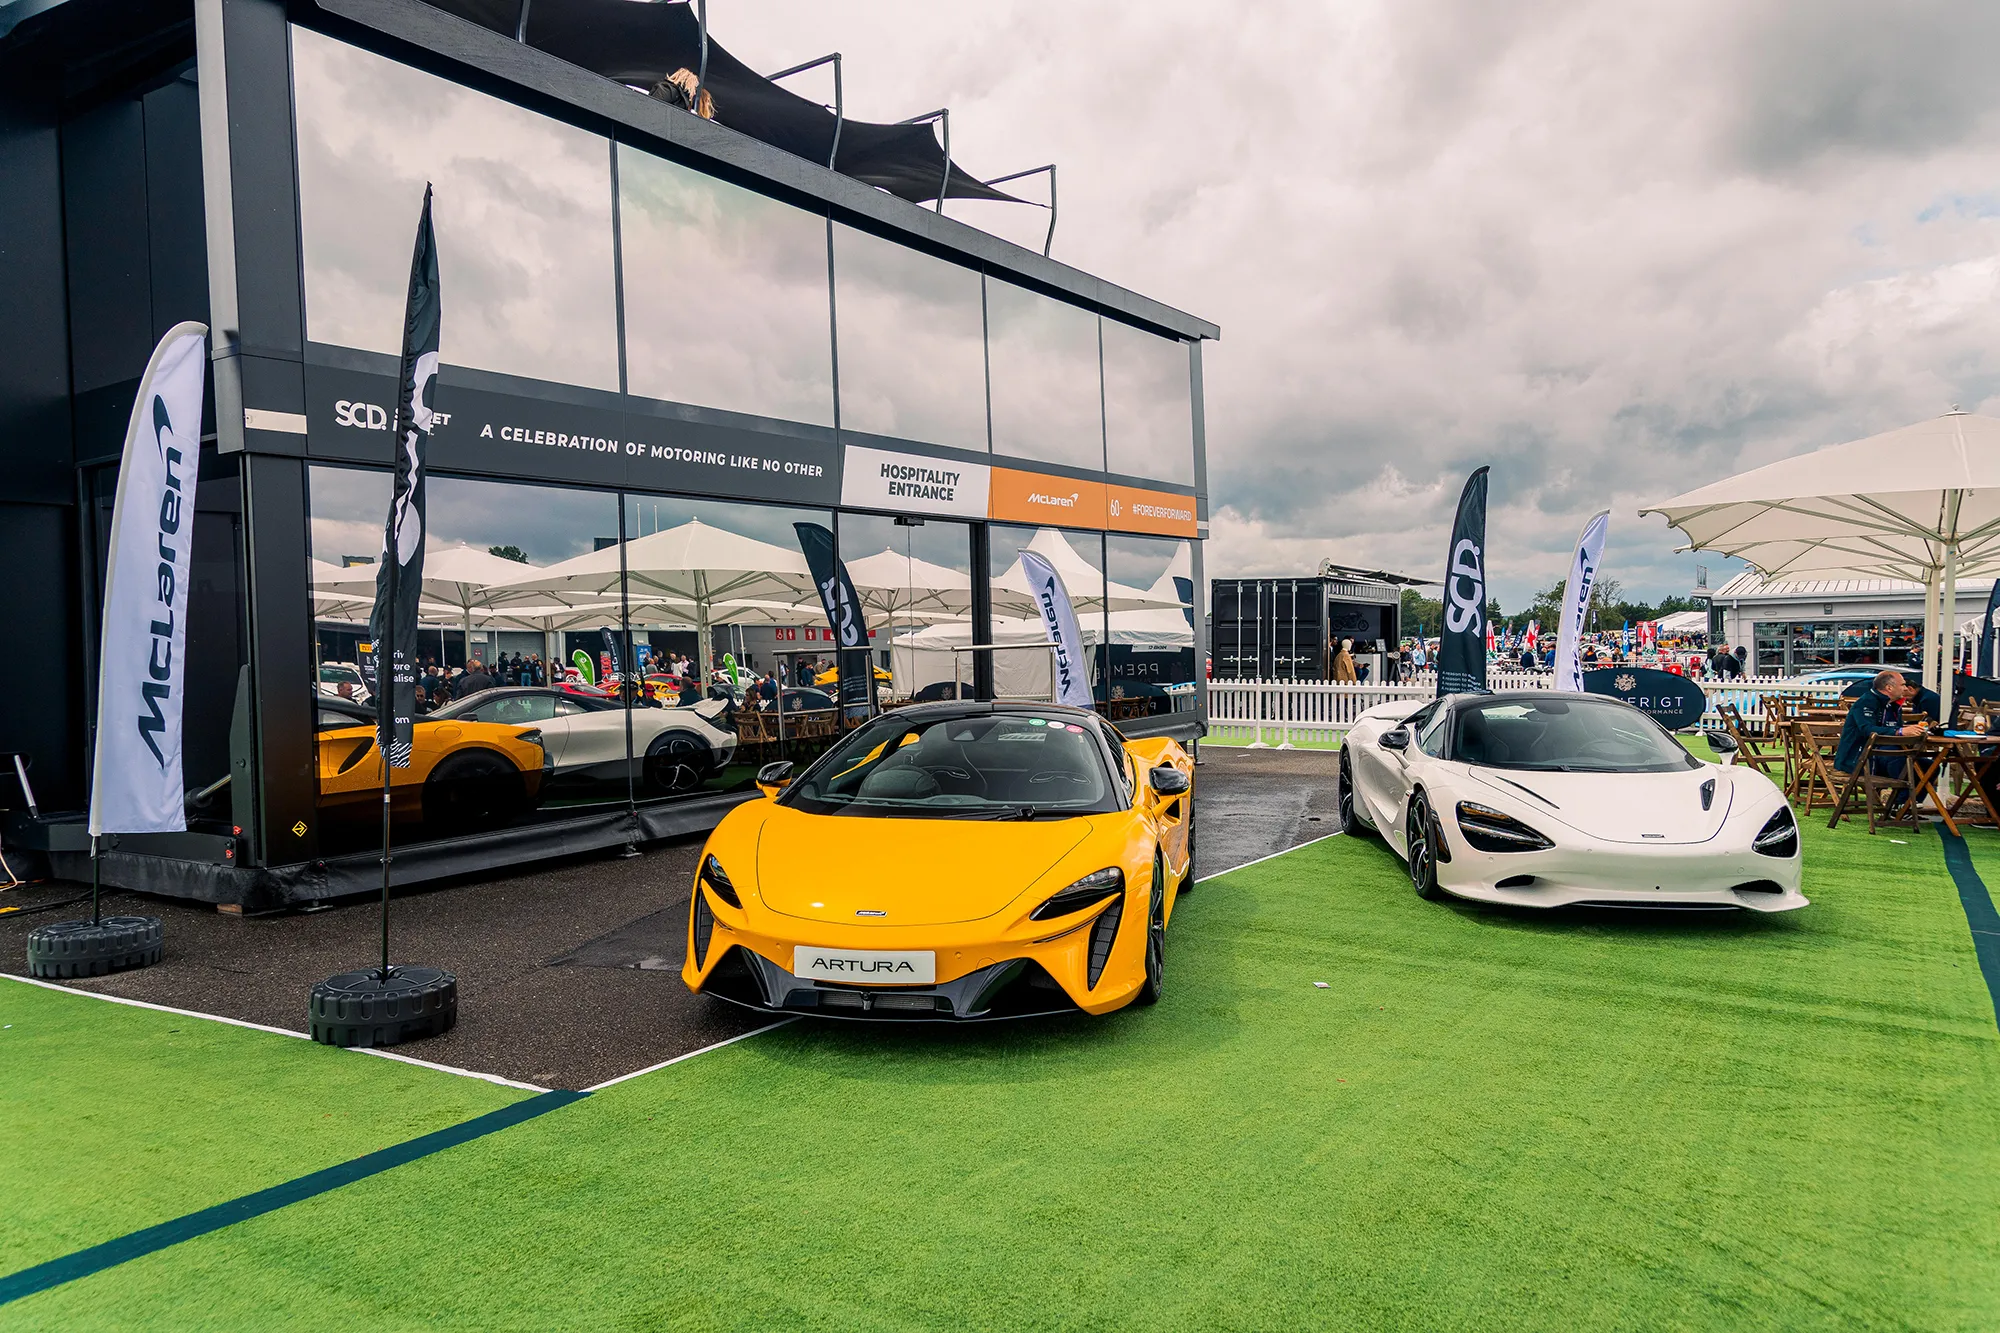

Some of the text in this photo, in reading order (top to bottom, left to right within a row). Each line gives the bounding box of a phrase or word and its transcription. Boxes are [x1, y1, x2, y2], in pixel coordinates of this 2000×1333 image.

[479, 423, 823, 478] A CELEBRATION OF MOTORING LIKE NO OTHER
[880, 463, 960, 487] HOSPITALITY
[888, 481, 954, 502] ENTRANCE
[1027, 493, 1077, 508] McLaren
[1132, 503, 1193, 522] #FOREVERFORWARD
[138, 446, 183, 770] McLaren
[812, 957, 915, 973] ARTURA
